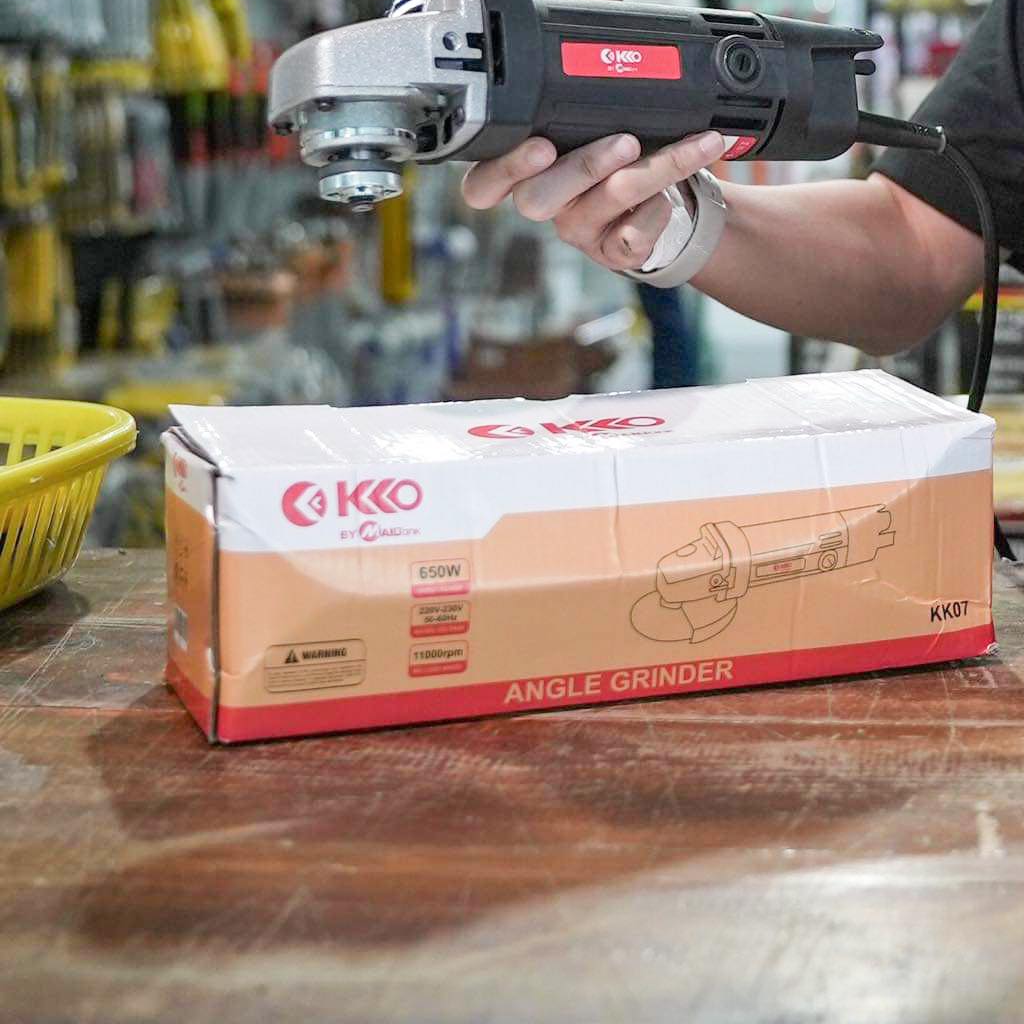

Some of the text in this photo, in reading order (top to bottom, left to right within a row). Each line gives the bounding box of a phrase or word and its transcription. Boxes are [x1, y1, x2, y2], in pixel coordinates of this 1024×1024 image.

[341, 529, 356, 540] BY
[419, 564, 461, 579] 650W
[930, 601, 968, 622] KK07
[302, 648, 347, 660] WARNING
[414, 648, 463, 660] 11000rpm
[504, 660, 734, 704] ANGLE GRINDER
